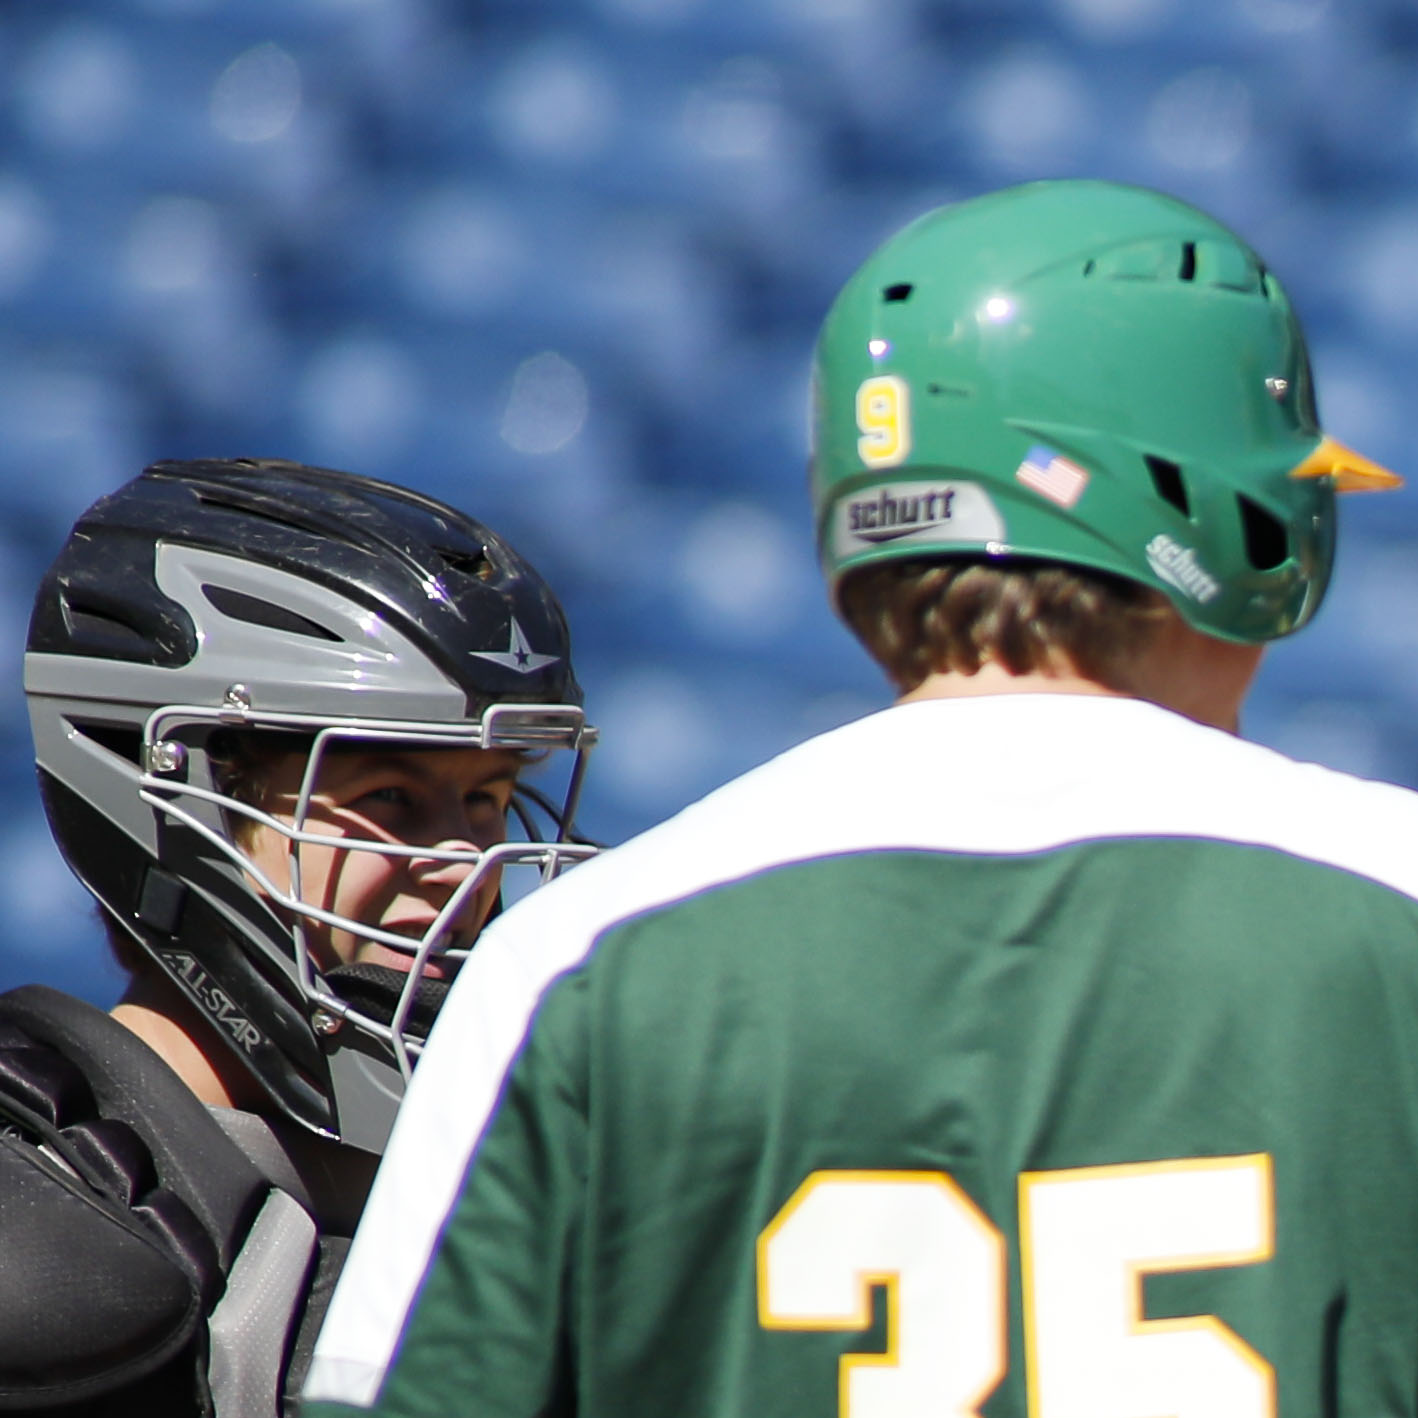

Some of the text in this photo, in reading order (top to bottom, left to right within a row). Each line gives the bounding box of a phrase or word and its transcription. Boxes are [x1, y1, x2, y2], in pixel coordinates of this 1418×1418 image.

[856, 374, 911, 469] 9
[849, 487, 954, 530] schutt
[162, 954, 260, 1053] ALL-STAR
